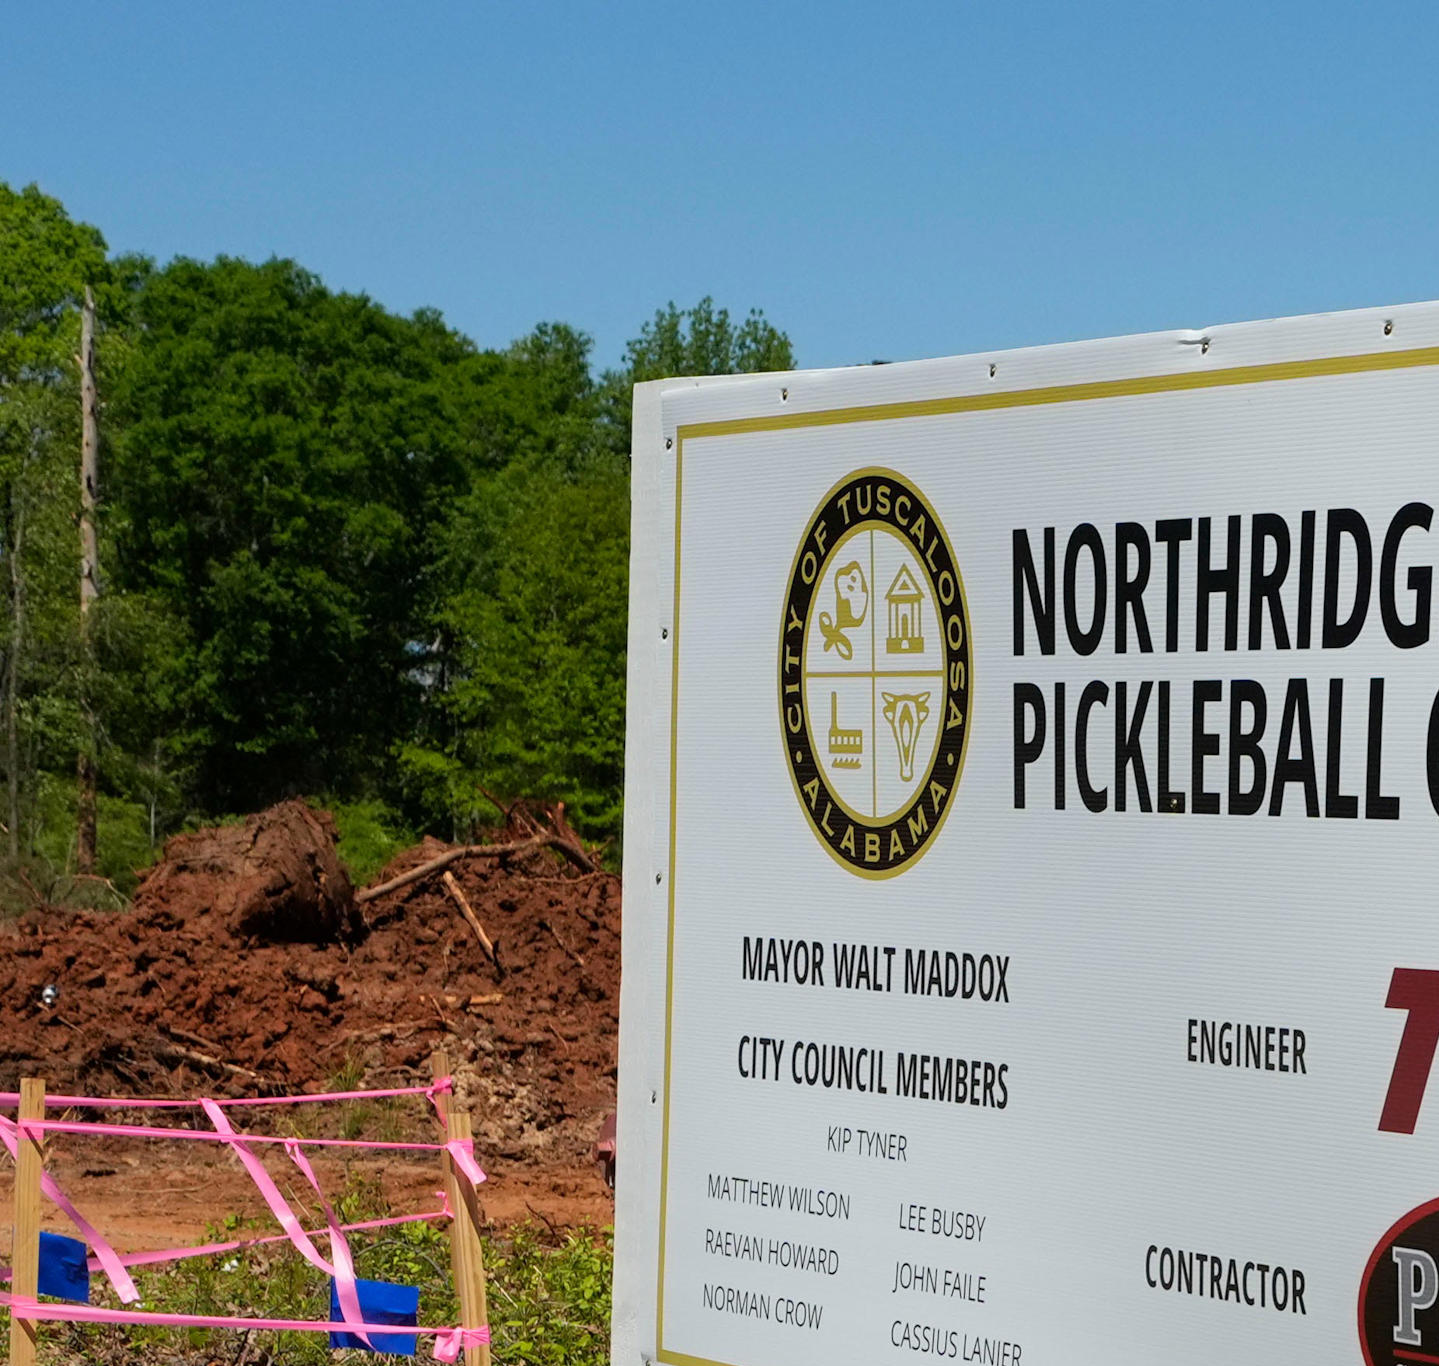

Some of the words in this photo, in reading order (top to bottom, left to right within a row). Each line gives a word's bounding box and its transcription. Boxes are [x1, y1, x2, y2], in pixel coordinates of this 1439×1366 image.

[785, 603, 804, 734] CITY
[801, 520, 829, 586] OF
[836, 484, 966, 732] TUSCALOOSA
[1013, 677, 1400, 820] PICKLEBALL
[802, 775, 948, 863] ALABAMA
[742, 936, 824, 986] MAYOR
[834, 943, 895, 992] WALT
[905, 948, 1009, 1003] MADDOX
[738, 1035, 784, 1081] CITY
[792, 1041, 887, 1094] COUNCIL
[896, 1052, 1008, 1109] MEMBERS
[1188, 1019, 1307, 1074] ENGINEER
[828, 1126, 851, 1152] KIP
[857, 1129, 907, 1162] TYNER
[708, 1173, 785, 1209] MATTHEW
[789, 1186, 850, 1220] WILSON
[899, 1203, 926, 1232] LEE
[932, 1208, 986, 1242] BUSBY
[705, 1228, 762, 1262] RAEVAN
[768, 1239, 839, 1275] HOWARD
[893, 1262, 938, 1294] JOHN
[943, 1270, 987, 1303] FAILE
[1145, 1245, 1307, 1315] CONTRACTOR
[703, 1284, 770, 1320] NORMAN
[775, 1298, 823, 1330] CROW
[891, 1320, 958, 1358] CASSIUS
